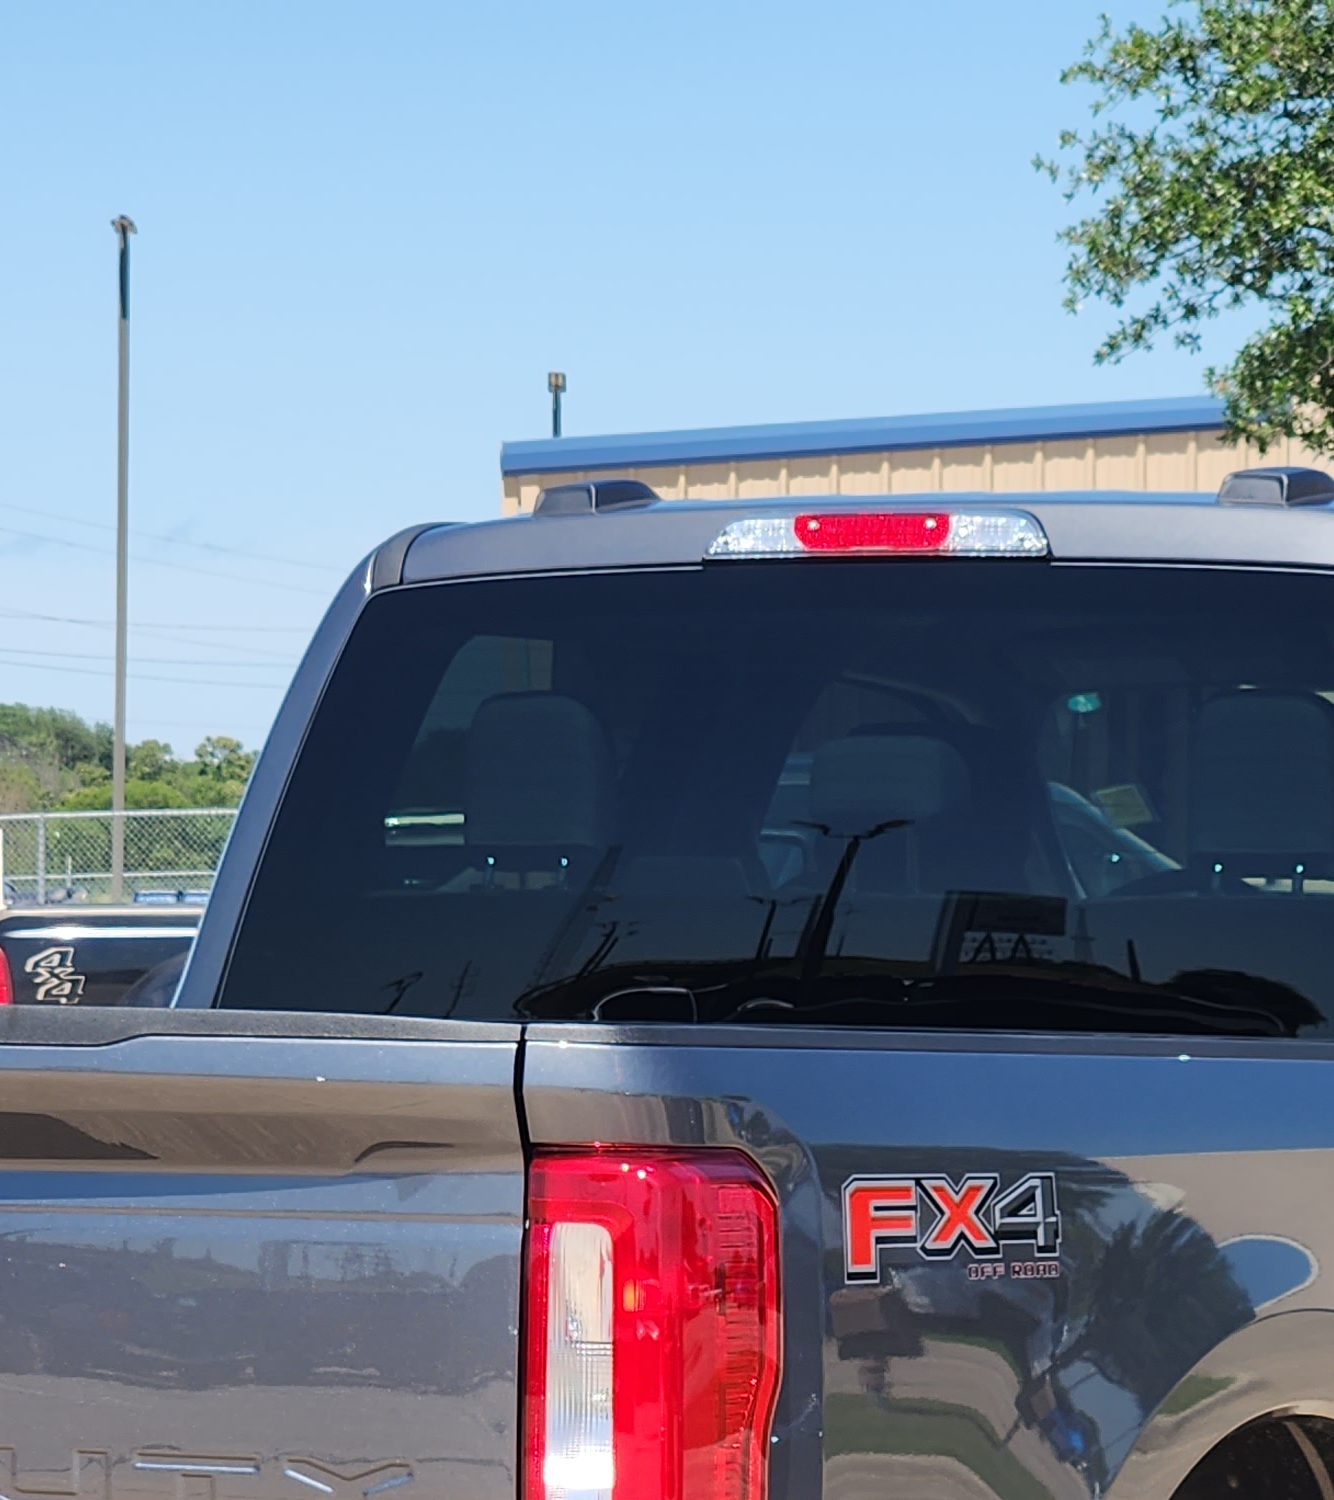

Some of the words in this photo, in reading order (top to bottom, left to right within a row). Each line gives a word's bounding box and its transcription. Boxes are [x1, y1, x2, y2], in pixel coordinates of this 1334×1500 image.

[841, 1171, 1063, 1284] FX4
[967, 1263, 1006, 1280] OFF
[1011, 1261, 1060, 1279] ROAD
